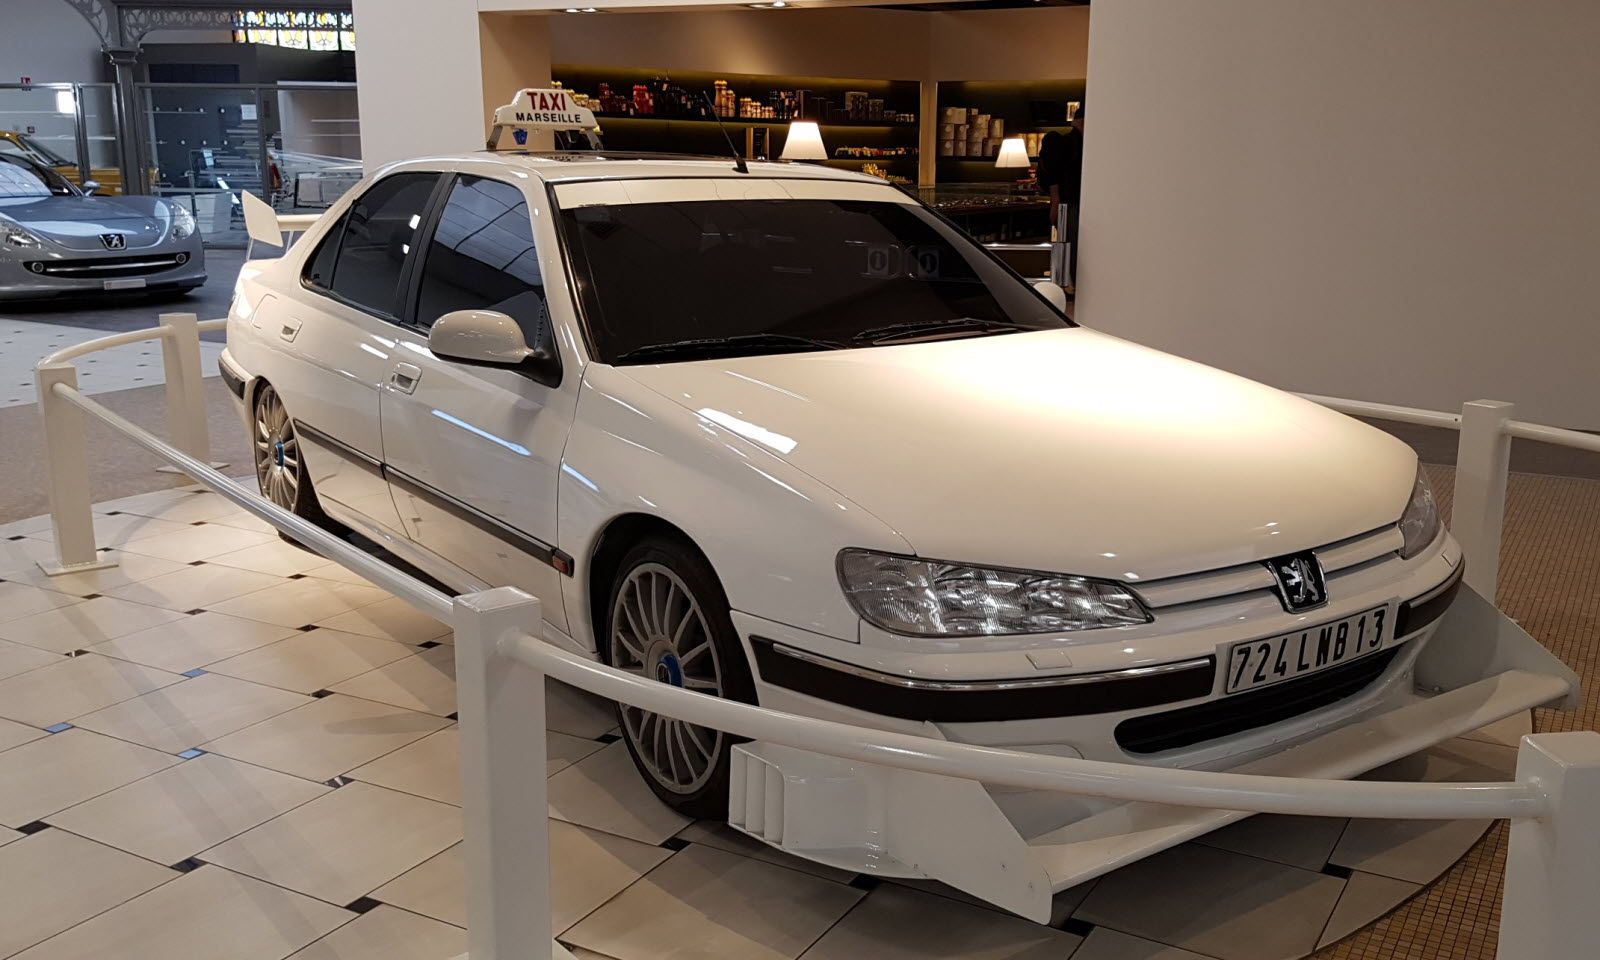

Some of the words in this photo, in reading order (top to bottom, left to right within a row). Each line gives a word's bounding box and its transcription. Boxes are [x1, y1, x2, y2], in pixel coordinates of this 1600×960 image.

[527, 92, 566, 111] TAXI
[516, 113, 581, 123] MARSEILLE
[1232, 638, 1288, 689] 724
[1297, 621, 1349, 672] LNB
[1356, 609, 1386, 653] 13
